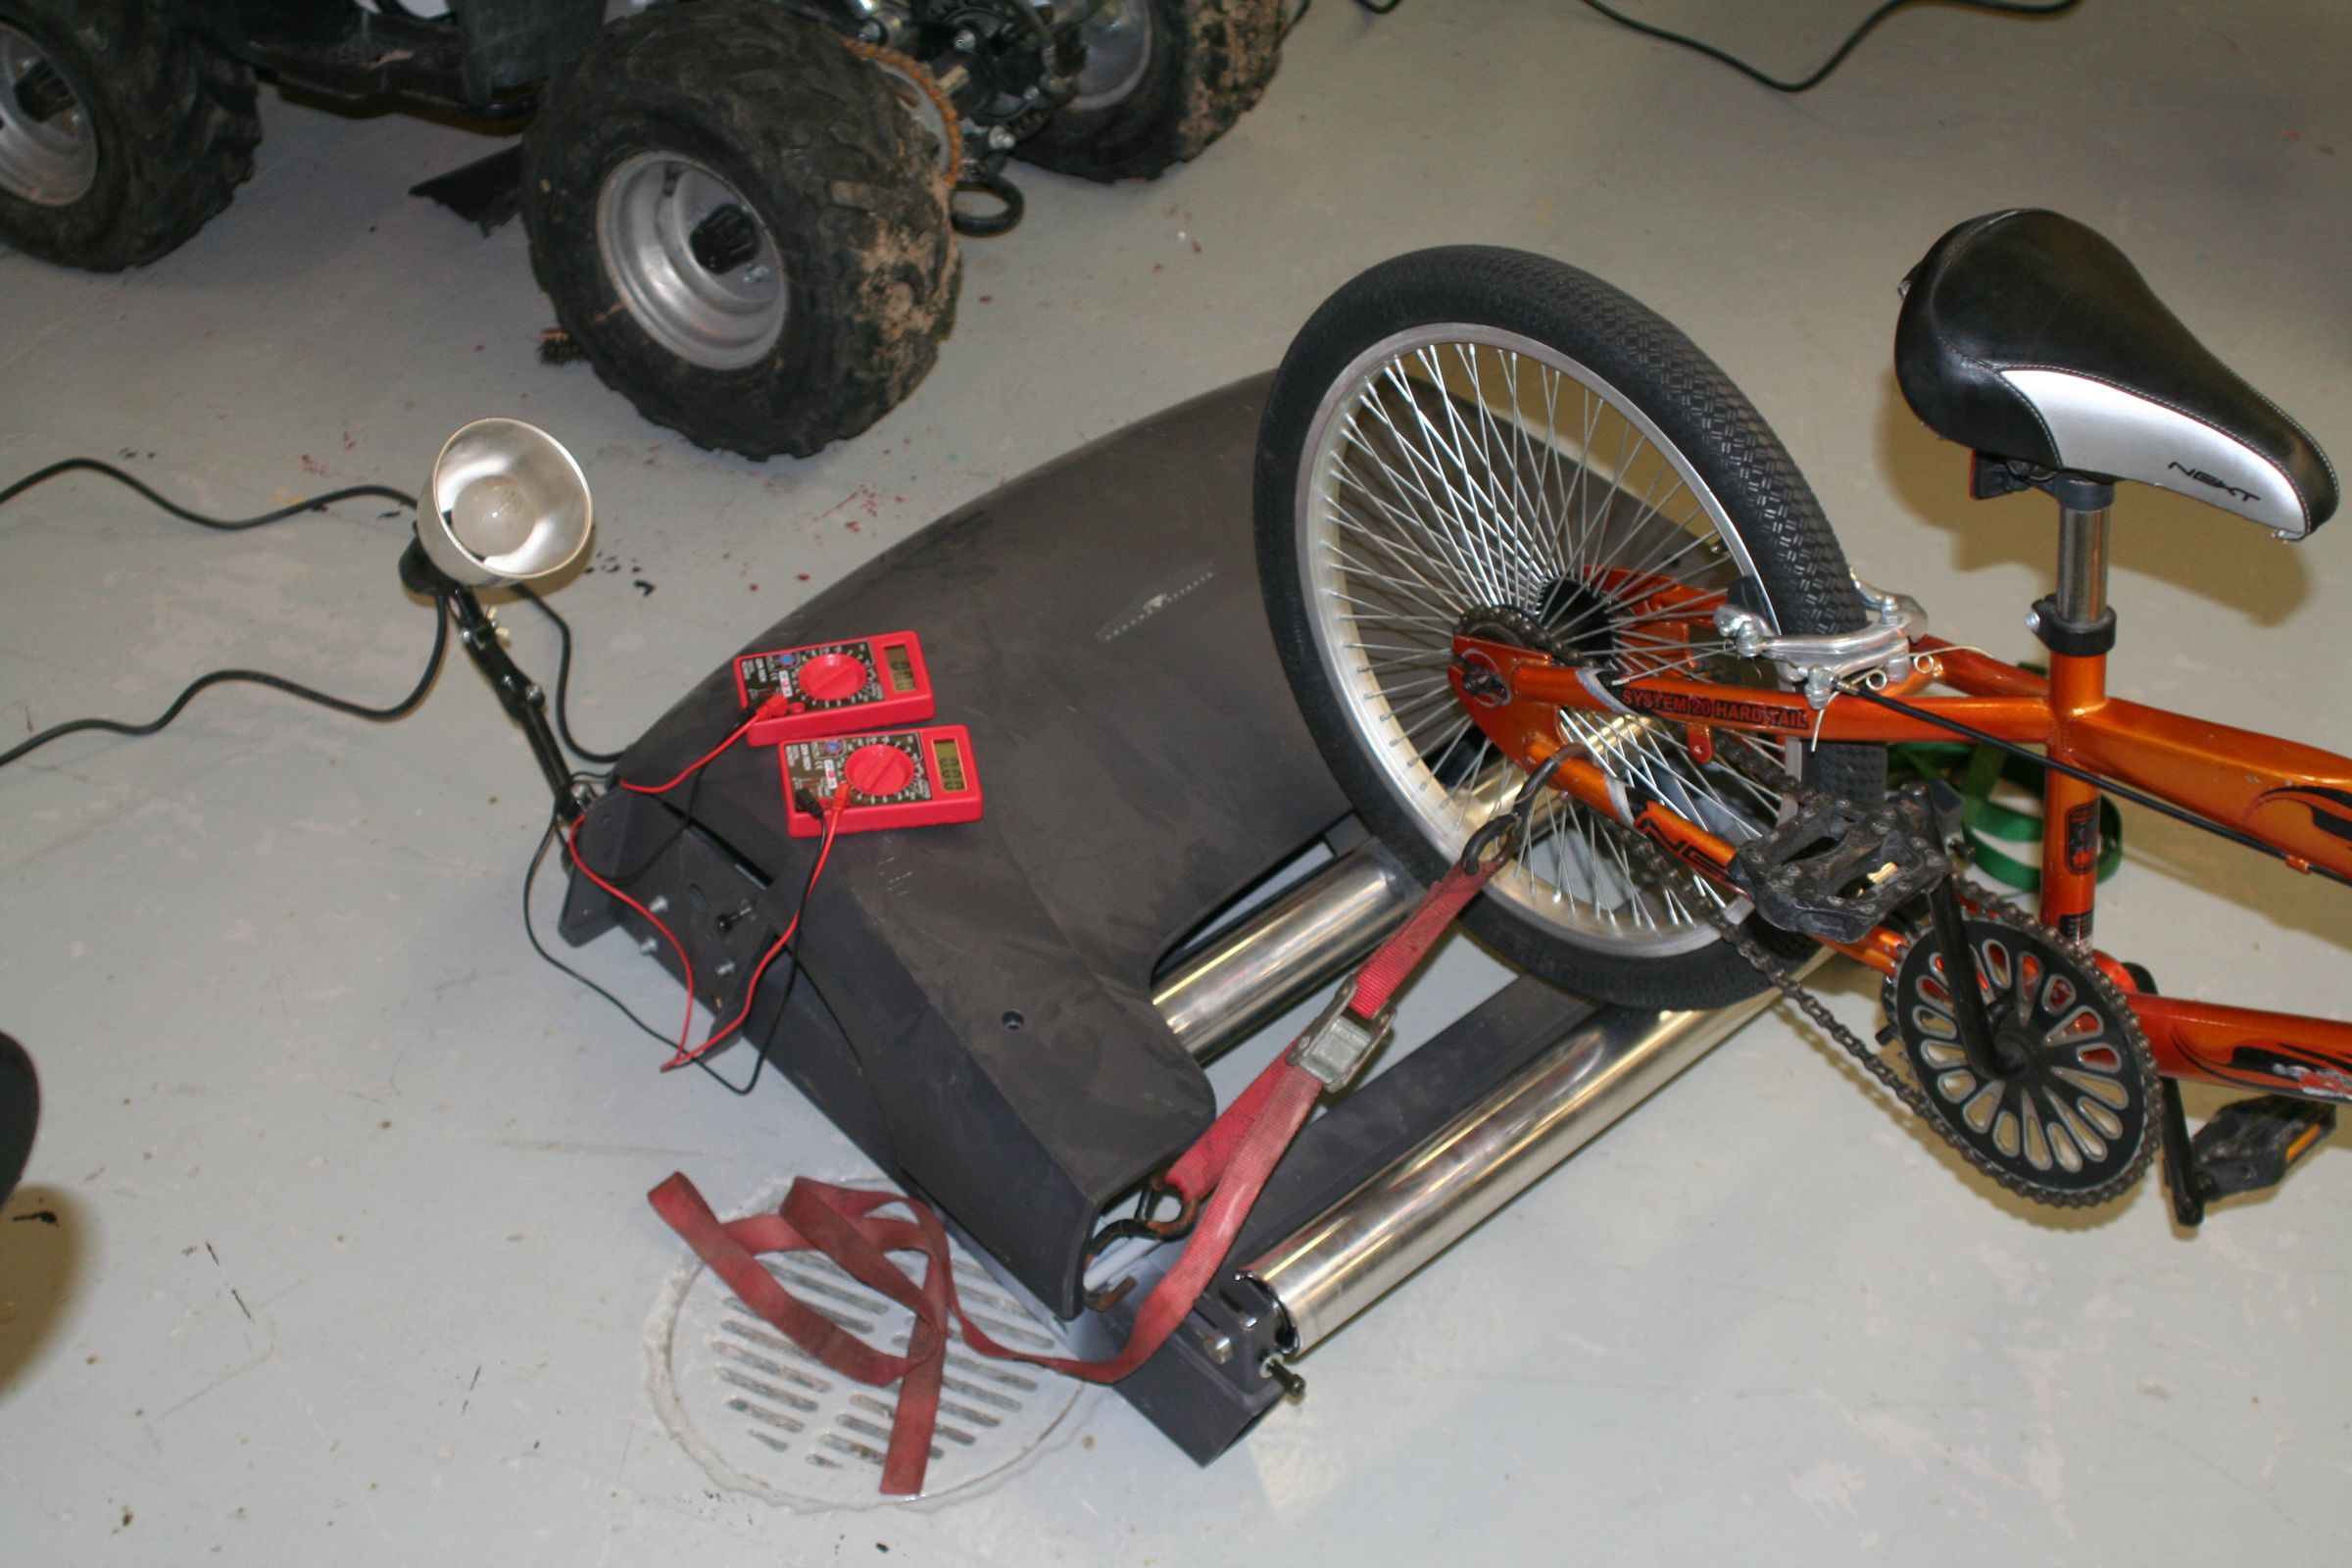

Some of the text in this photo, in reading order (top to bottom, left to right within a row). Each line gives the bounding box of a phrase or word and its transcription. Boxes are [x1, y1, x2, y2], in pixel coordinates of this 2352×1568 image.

[2167, 461, 2261, 503] NEXT
[1622, 689, 1687, 713] SYSTEM
[1691, 697, 1712, 716] 20
[1638, 817, 1739, 884] NE
